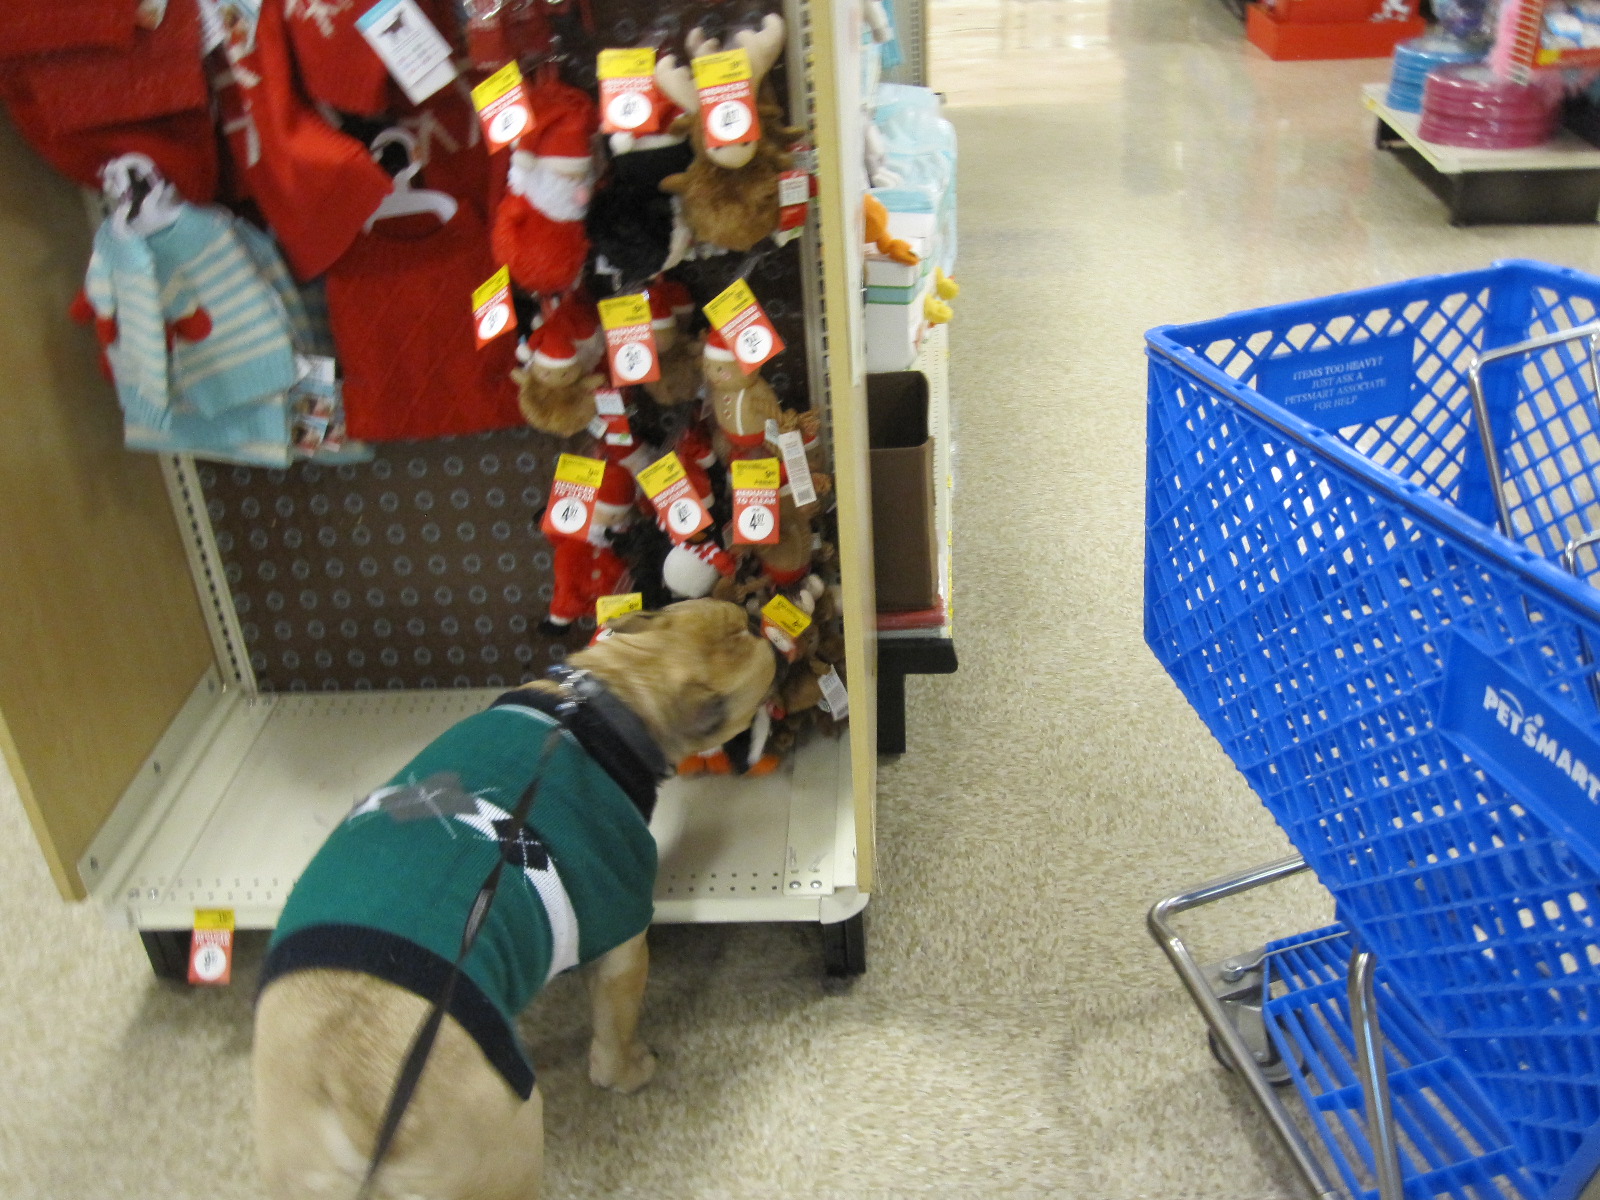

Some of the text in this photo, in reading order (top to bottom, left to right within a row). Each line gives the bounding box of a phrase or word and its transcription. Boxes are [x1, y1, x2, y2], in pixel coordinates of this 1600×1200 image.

[1293, 367, 1323, 381] ITEMS
[1325, 364, 1345, 375] TOO
[1312, 371, 1364, 389] JUST ASK A
[1285, 378, 1387, 405] PETSMART ASSOCIATE
[1314, 395, 1358, 411] FOR HELP
[1483, 685, 1600, 804] PETSMART
